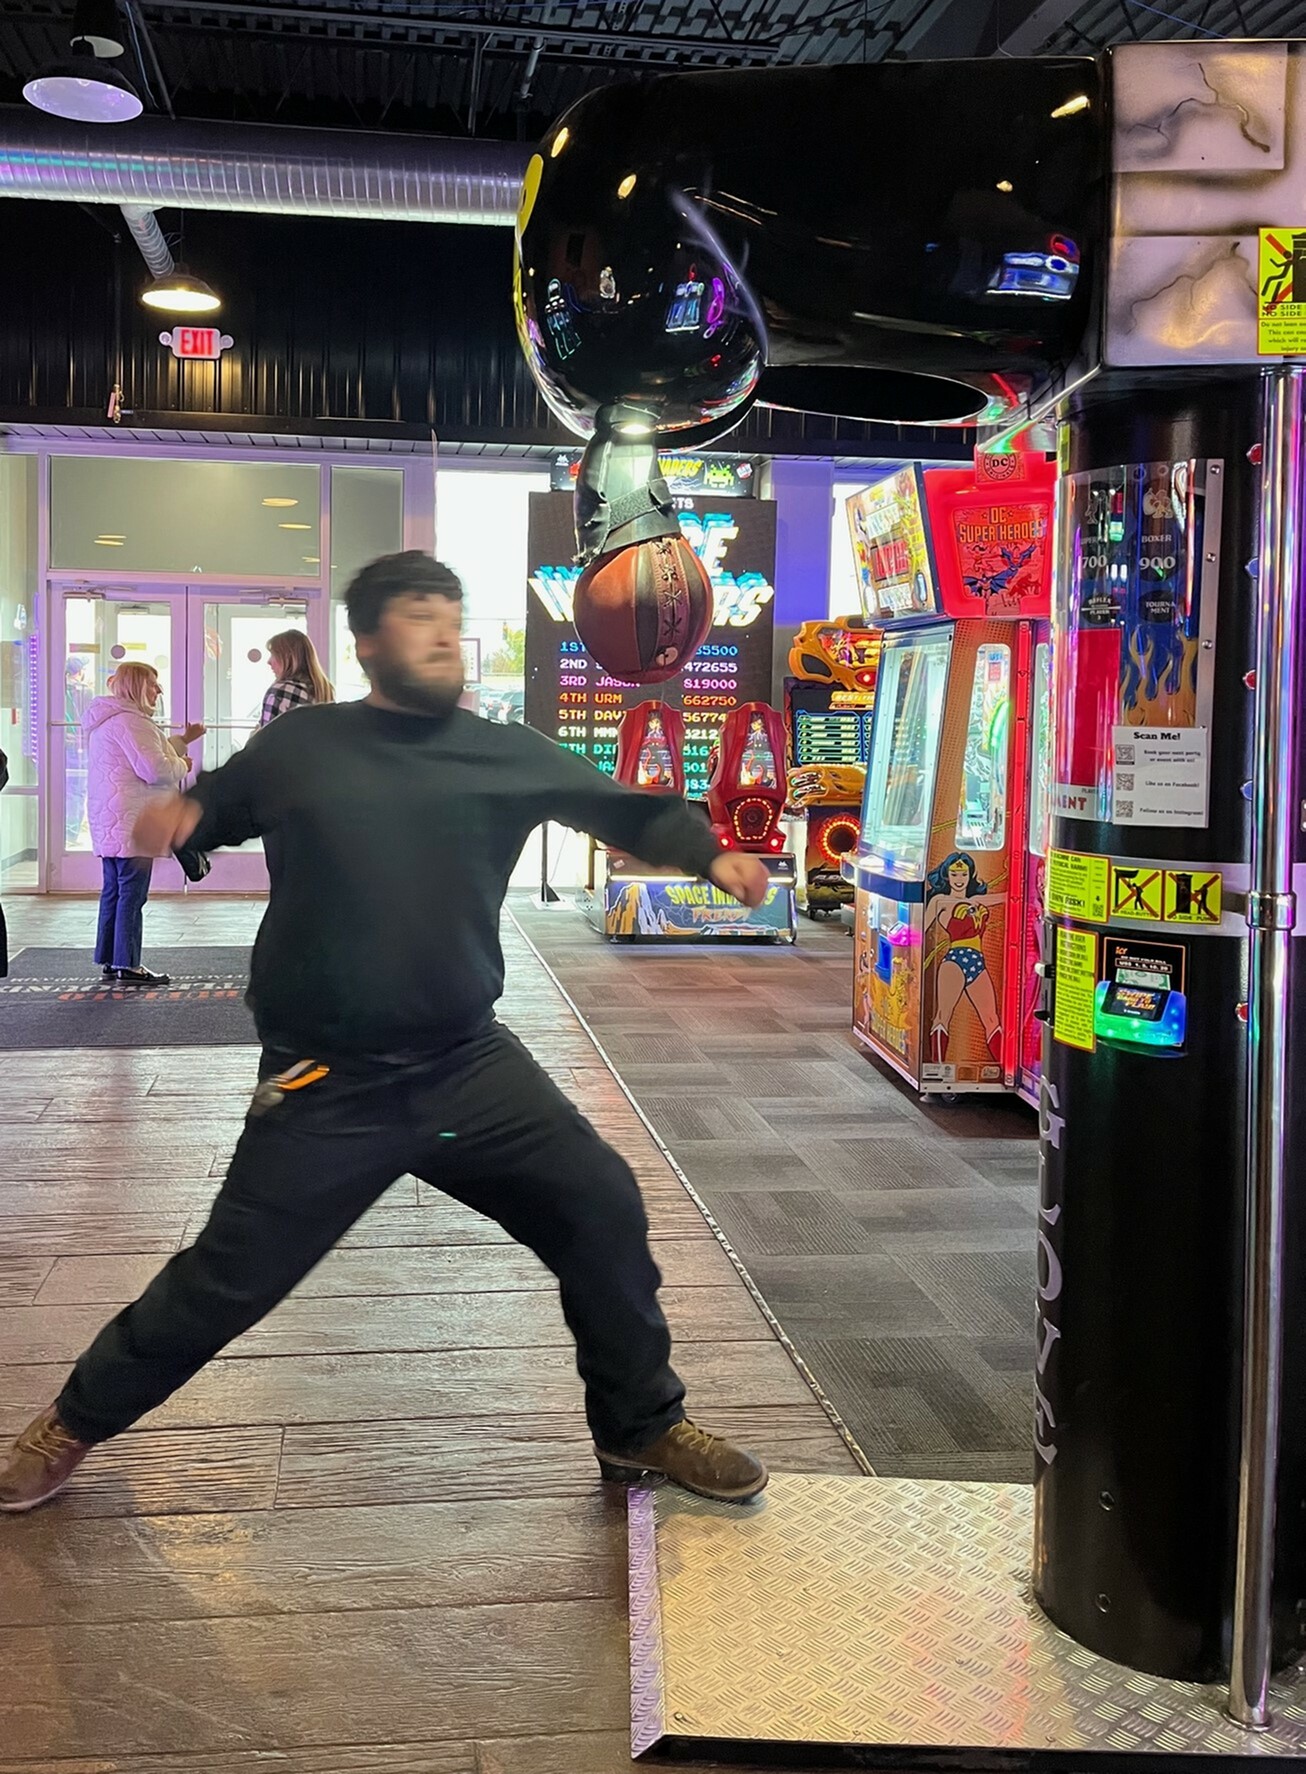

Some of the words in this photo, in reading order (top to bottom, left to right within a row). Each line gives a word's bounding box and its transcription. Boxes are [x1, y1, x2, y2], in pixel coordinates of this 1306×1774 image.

[181, 329, 214, 355] EXIT
[992, 458, 1008, 467] DC
[991, 507, 1007, 524] DC
[960, 523, 997, 543] SUPER
[1000, 519, 1044, 541] HEROES
[1142, 534, 1172, 543] BOXER
[1082, 555, 1107, 568] 700
[1139, 556, 1176, 570] 900
[560, 659, 587, 669] 2ND
[560, 676, 587, 686] 3RD
[683, 678, 737, 689] 819000
[560, 693, 587, 703] 4TH
[594, 693, 622, 703] URM
[683, 696, 737, 706] 662750
[558, 709, 586, 720] 5TH
[558, 726, 586, 738] 6TH
[1160, 732, 1181, 740] Me!
[665, 885, 711, 905] SPACE
